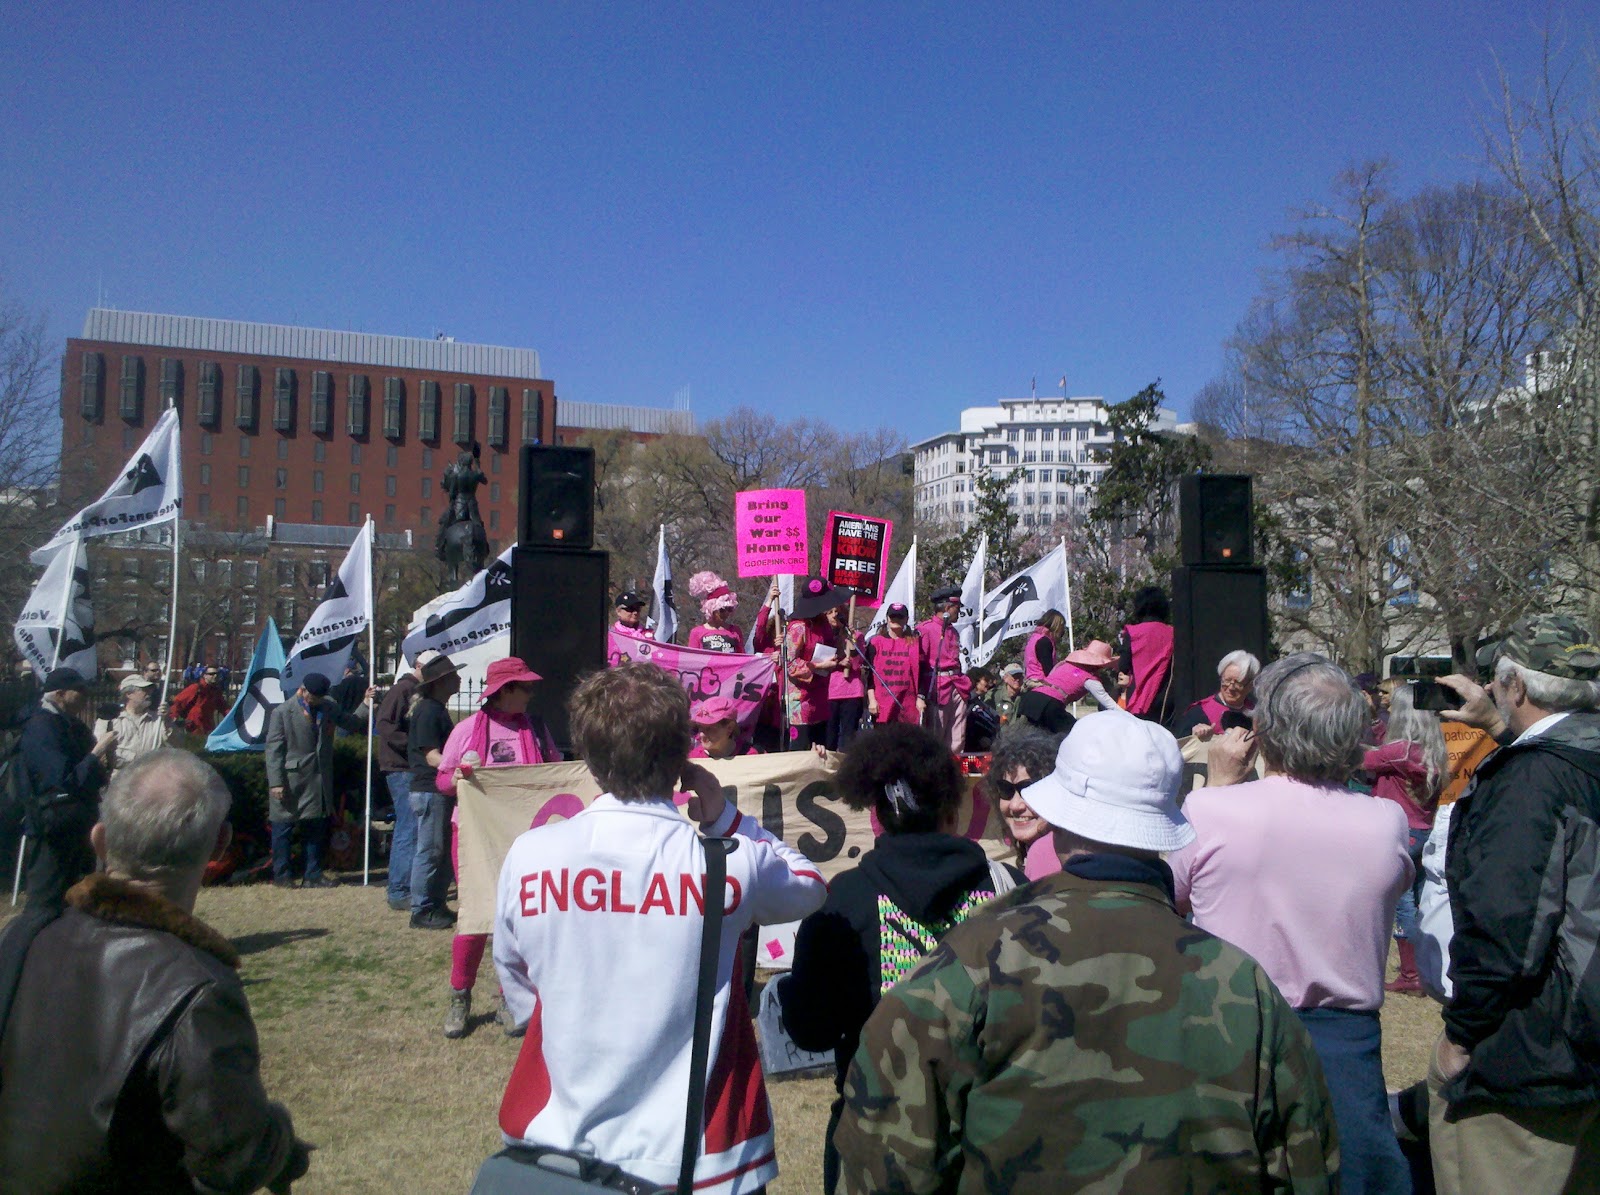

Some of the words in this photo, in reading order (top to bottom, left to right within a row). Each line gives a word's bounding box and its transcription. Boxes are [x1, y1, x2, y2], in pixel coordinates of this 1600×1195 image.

[747, 500, 789, 511] Bring
[750, 528, 781, 538] War
[838, 528, 862, 538] HAVE
[863, 531, 879, 541] THE
[746, 543, 790, 554] Home
[837, 543, 877, 559] KNOW
[835, 557, 876, 575] FREE
[733, 672, 764, 702] is
[519, 867, 742, 917] ENGLAND
